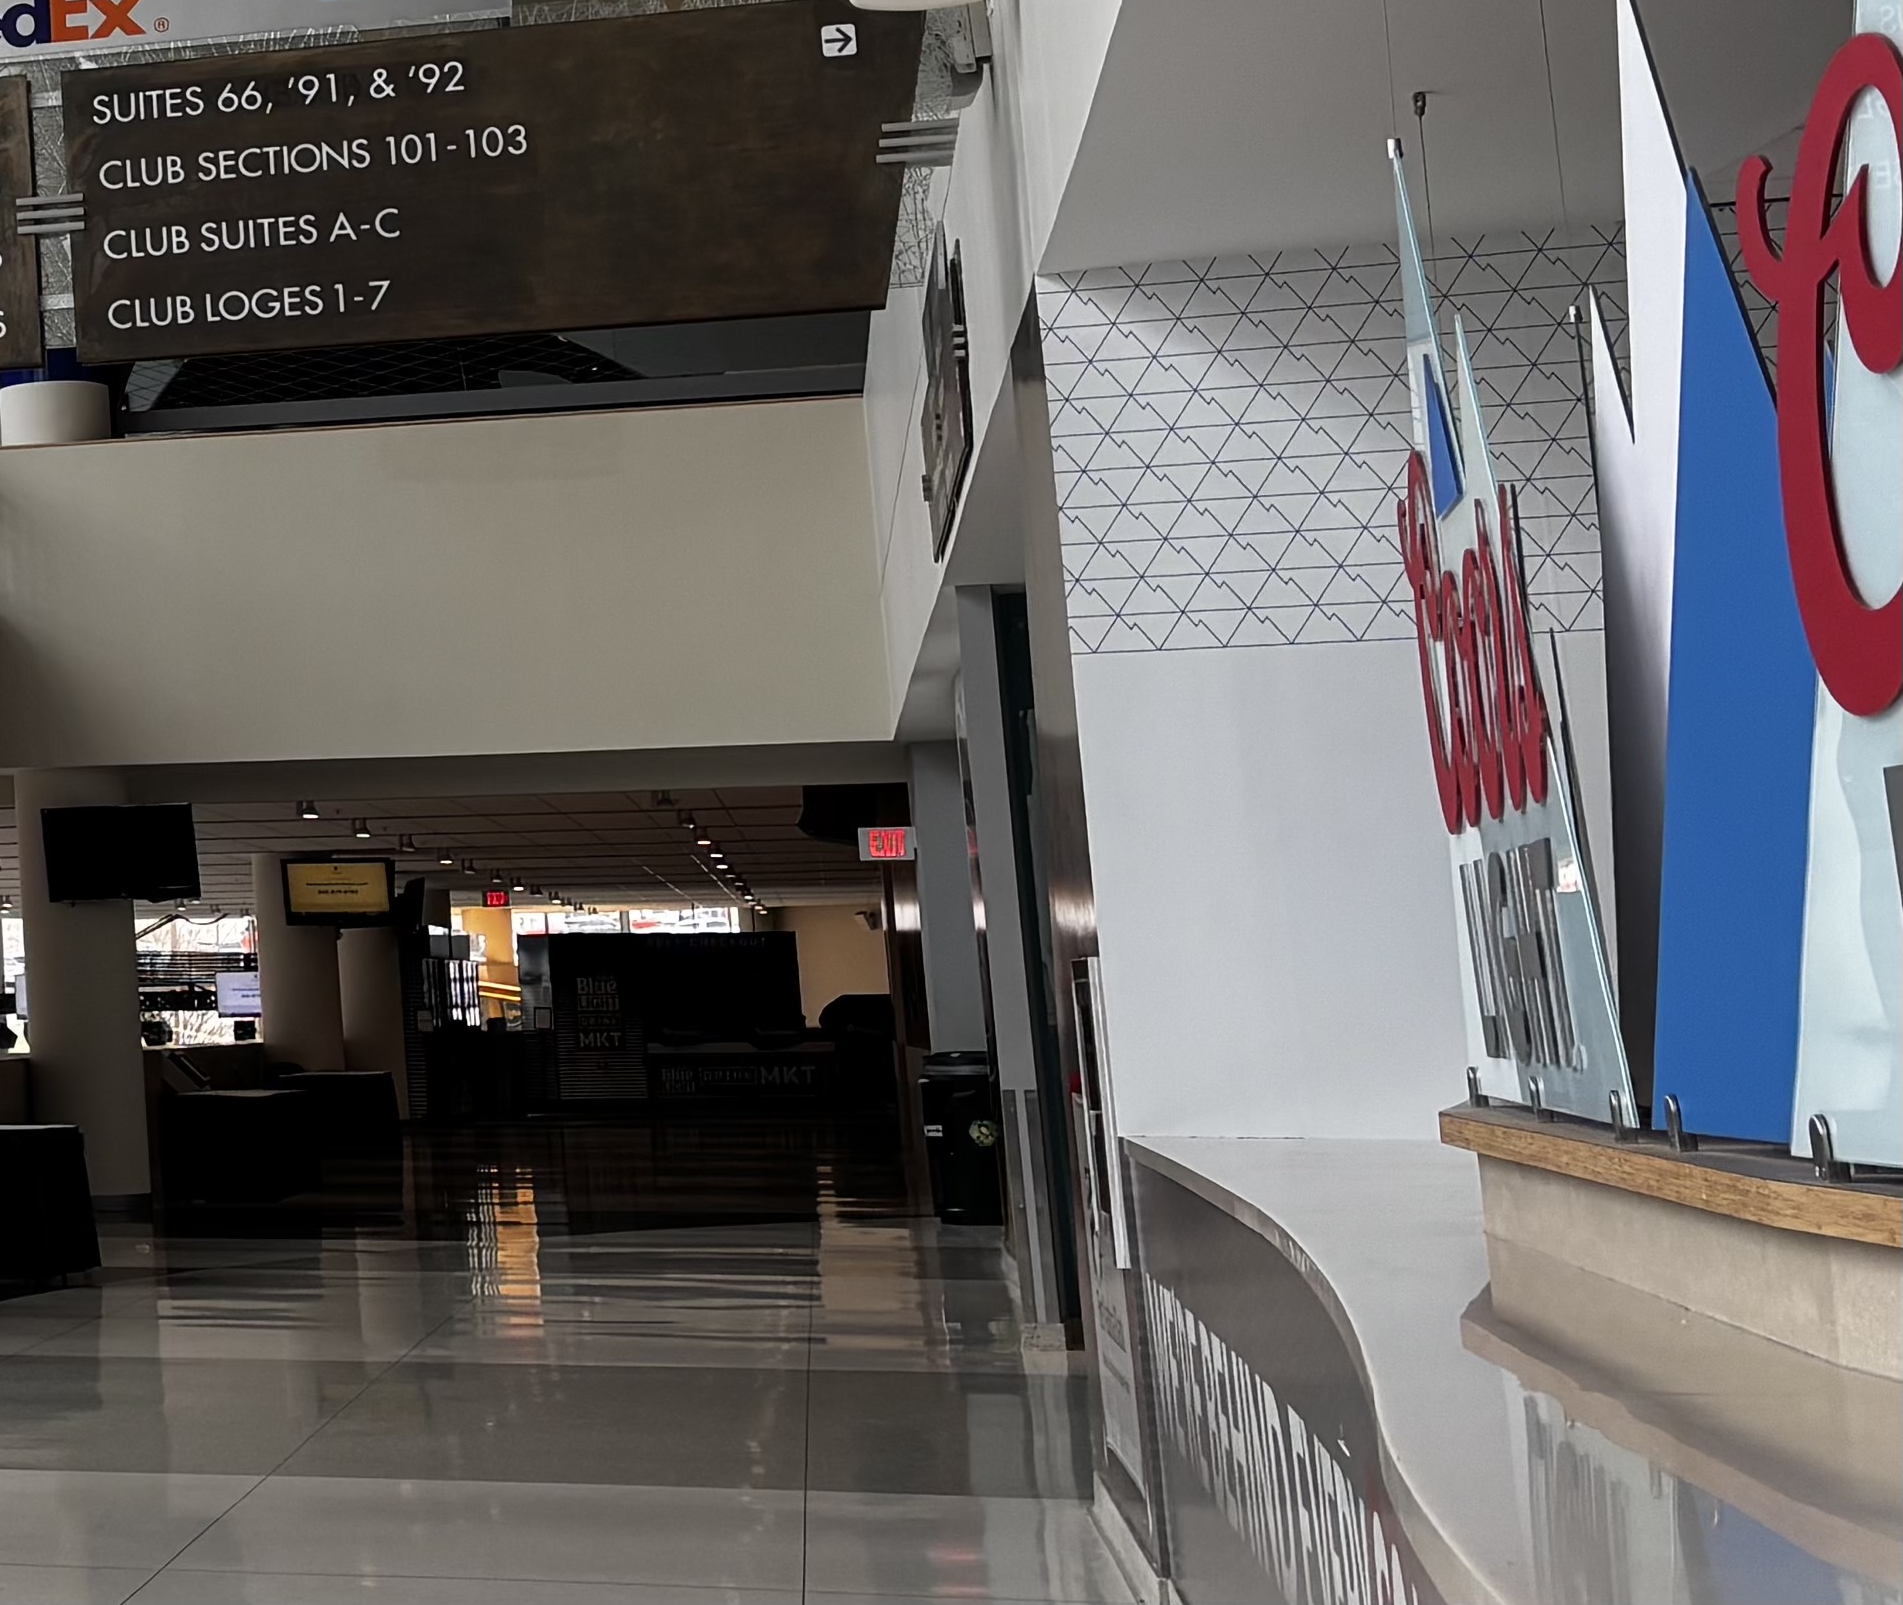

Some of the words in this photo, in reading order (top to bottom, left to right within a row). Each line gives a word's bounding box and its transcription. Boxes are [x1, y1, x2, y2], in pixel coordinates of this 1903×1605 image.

[92, 86, 205, 125] SUITES
[217, 80, 274, 118] 66,
[370, 66, 396, 100] &
[98, 155, 185, 191] CLUB
[198, 138, 372, 183] SECTIONS
[385, 123, 529, 167] 101-103
[104, 224, 190, 261] CLUB
[200, 214, 318, 251] SUITES
[329, 206, 402, 243] A-C
[108, 294, 195, 330] CLUB
[206, 284, 324, 323] LOGES
[334, 279, 392, 315] 1-7
